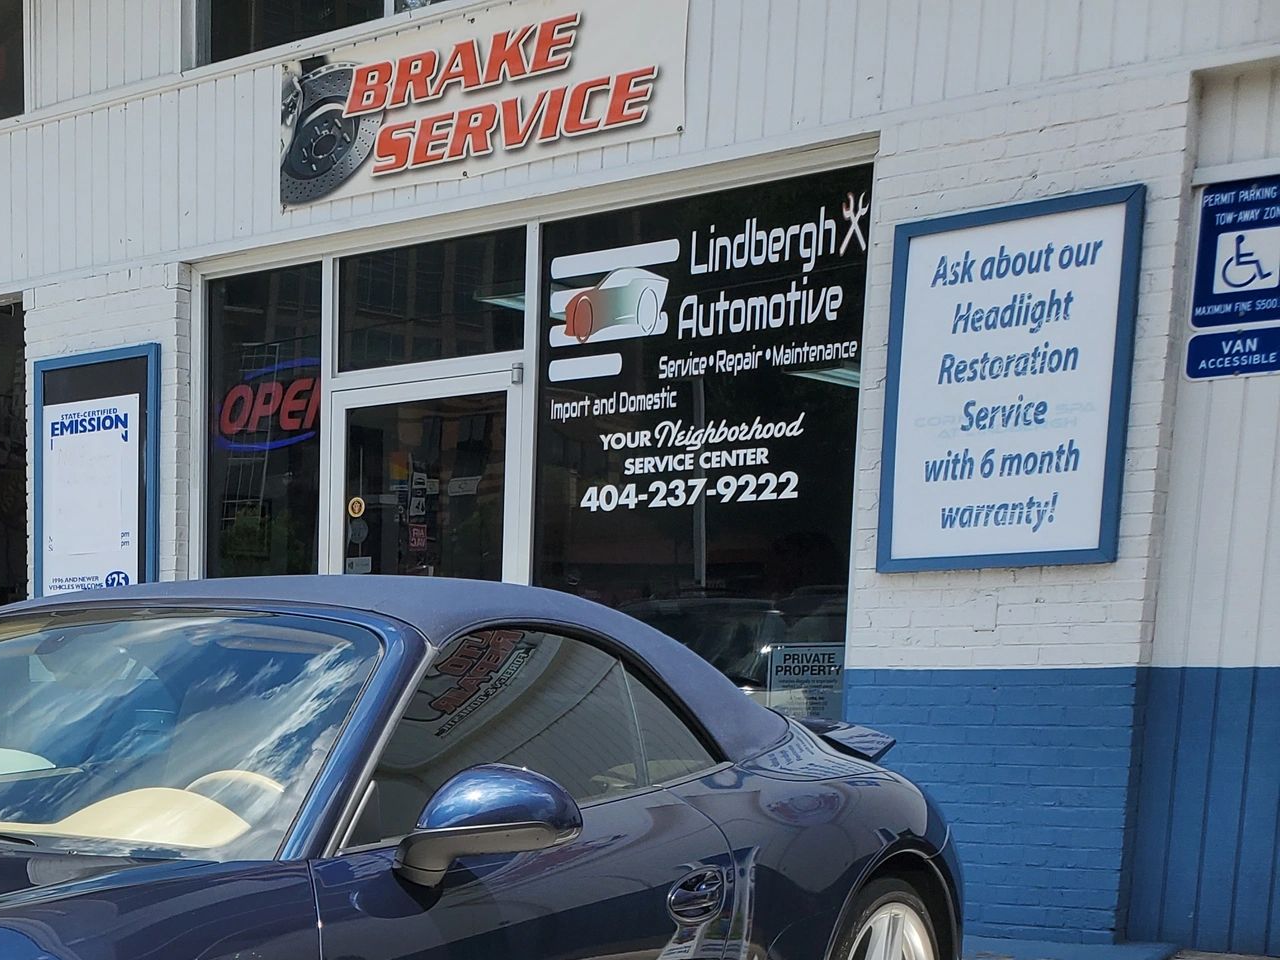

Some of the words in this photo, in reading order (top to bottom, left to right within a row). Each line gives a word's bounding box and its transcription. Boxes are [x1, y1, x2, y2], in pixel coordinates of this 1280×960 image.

[343, 11, 580, 117] BRAKE
[372, 65, 657, 175] SERVICE
[1203, 192, 1236, 207] PERMIT
[1239, 186, 1277, 202] PARKING
[1215, 208, 1260, 225] TOW-AWAY
[1263, 207, 1280, 219] ZON
[690, 205, 837, 275] Lindbergh
[930, 249, 981, 288] Ask
[980, 244, 1054, 282] about
[1058, 239, 1104, 269] our
[677, 276, 843, 340] Automotive
[951, 288, 1075, 335] Headlight
[1195, 303, 1232, 316] MAXIMUM
[1234, 301, 1253, 312] FINE
[1255, 298, 1280, 310] $500
[658, 351, 707, 380] Service
[715, 345, 763, 378] Repair
[772, 339, 858, 368] Maintenance
[937, 341, 1079, 385] Restoration
[1198, 352, 1278, 370] ACCESSIBLE
[1222, 337, 1258, 354] VAN
[61, 408, 118, 421] STATE-CERTIFIED
[550, 396, 590, 423] Import
[593, 392, 616, 415] and
[619, 385, 677, 415] Domestic
[959, 394, 1049, 432] Service
[50, 413, 128, 438] EMISSION
[599, 429, 652, 451] YOUR
[654, 411, 806, 451] Neighborhood
[623, 453, 694, 475] SERVICE
[699, 447, 769, 470] CENTER
[924, 448, 974, 483] with
[980, 449, 994, 478] 6
[999, 438, 1081, 478] month
[579, 470, 799, 513] 404-237-9222
[940, 491, 1059, 533] warranty!
[776, 665, 842, 676] PROPERTY
[783, 653, 836, 664] PRIVATE
